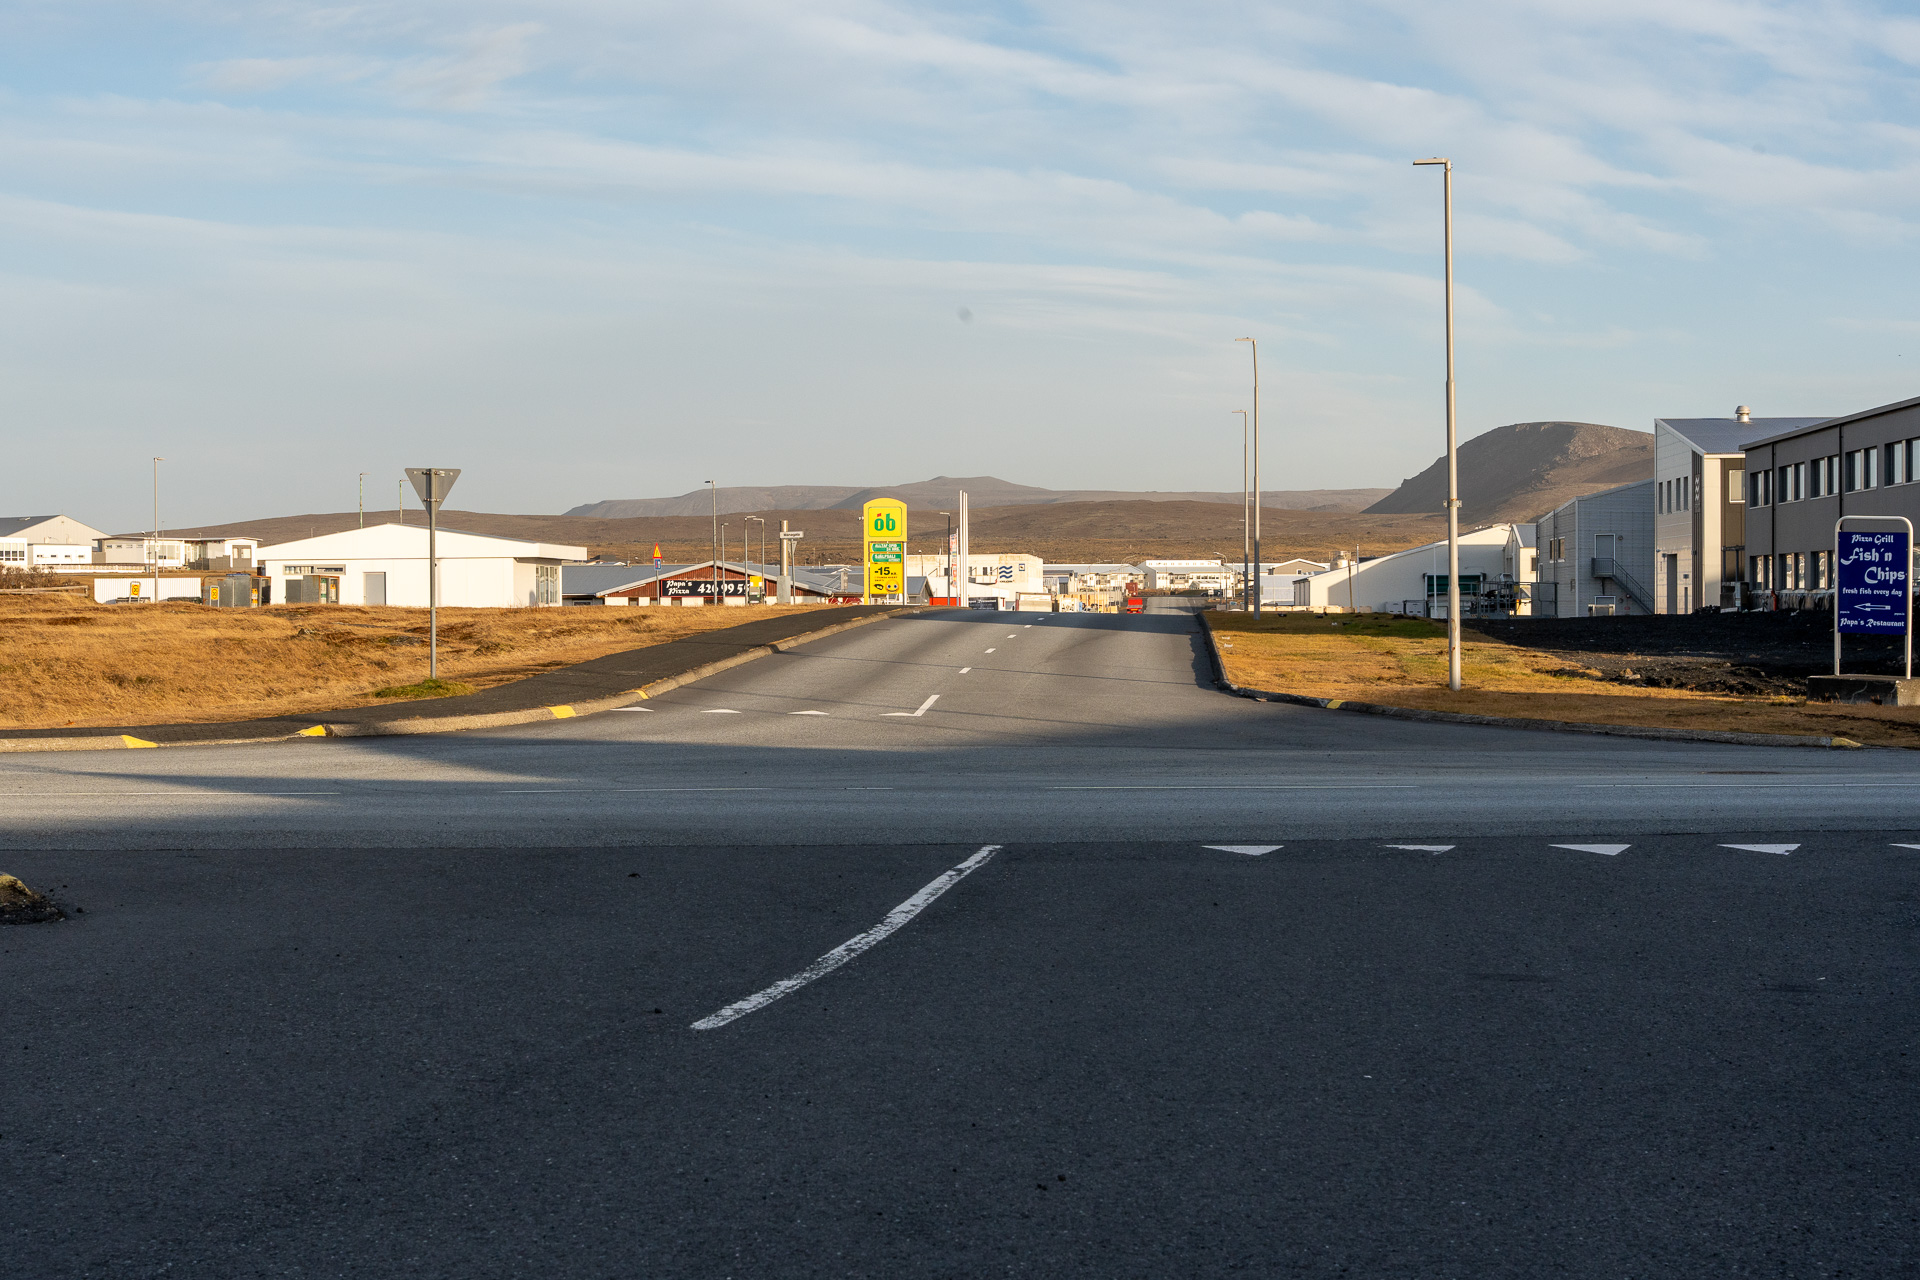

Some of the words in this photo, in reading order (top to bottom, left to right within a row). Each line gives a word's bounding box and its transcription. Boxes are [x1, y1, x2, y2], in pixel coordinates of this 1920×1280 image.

[1851, 534, 1873, 544] Pizza
[1874, 534, 1894, 545] Grill
[1864, 566, 1905, 584] Chips
[668, 587, 690, 596] Pizza
[1842, 587, 1858, 595] fresh
[1859, 587, 1872, 595] fish
[1873, 589, 1890, 597] every
[1890, 588, 1903, 597] day
[1865, 618, 1905, 628] Restaurant
